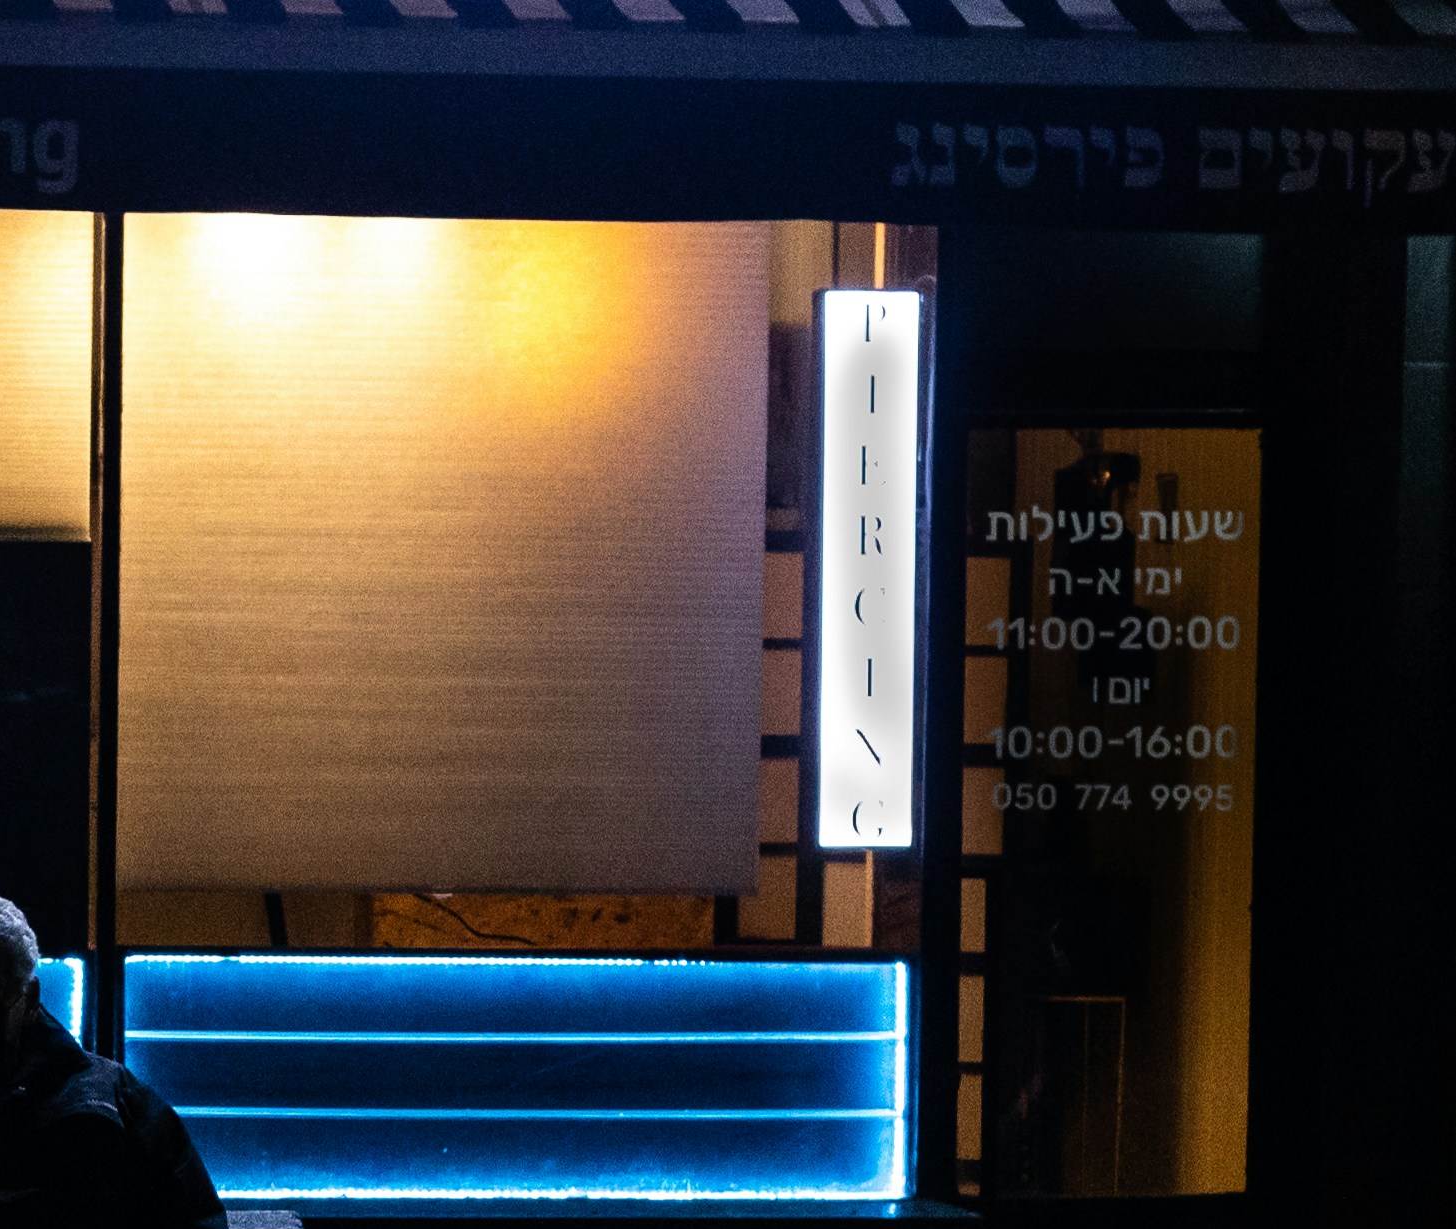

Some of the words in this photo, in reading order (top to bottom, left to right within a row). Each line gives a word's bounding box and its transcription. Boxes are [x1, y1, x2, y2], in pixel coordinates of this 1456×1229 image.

[892, 121, 1165, 190] פירסינג
[986, 504, 1124, 544] פעילות
[1140, 509, 1245, 543] שעות
[1048, 566, 1122, 596] א-ה
[1134, 566, 1183, 596] ימי
[987, 614, 1241, 651] 11:00-20:00
[1108, 676, 1151, 705] יום
[986, 724, 1237, 760] 10:00-16:00
[991, 782, 1058, 811] 050
[1075, 783, 1133, 811] 774
[1150, 783, 1235, 812] 9995
